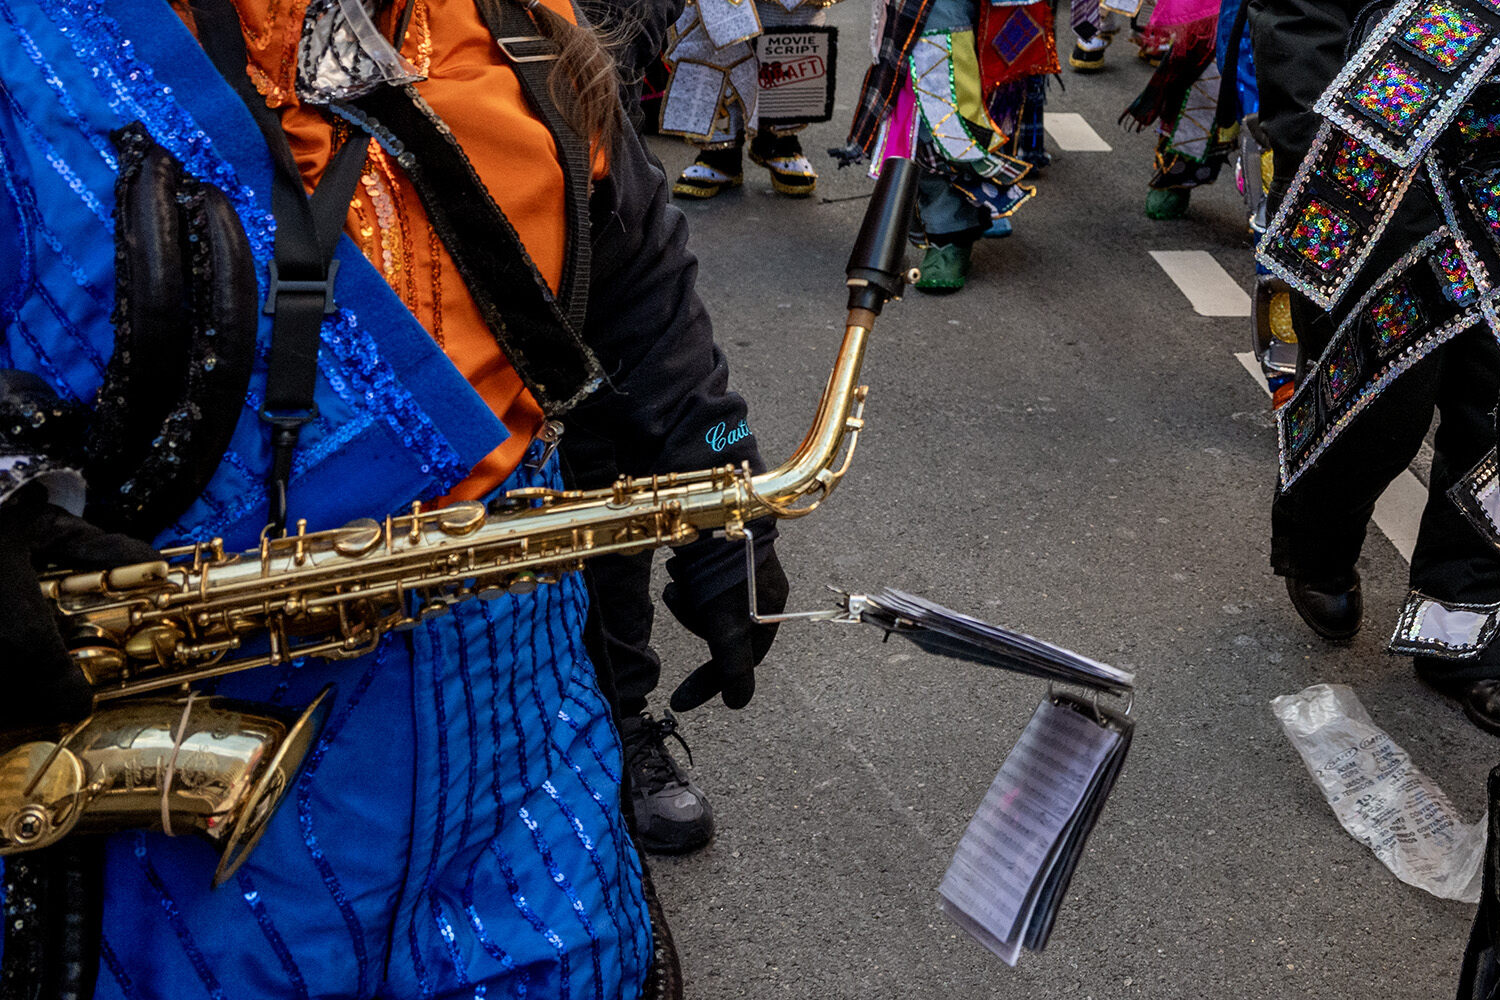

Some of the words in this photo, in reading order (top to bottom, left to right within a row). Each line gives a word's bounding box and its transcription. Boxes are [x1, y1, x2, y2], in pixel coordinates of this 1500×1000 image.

[768, 36, 817, 46] MOVIE
[765, 45, 819, 55] SCRIPT
[759, 59, 818, 89] DRAFT
